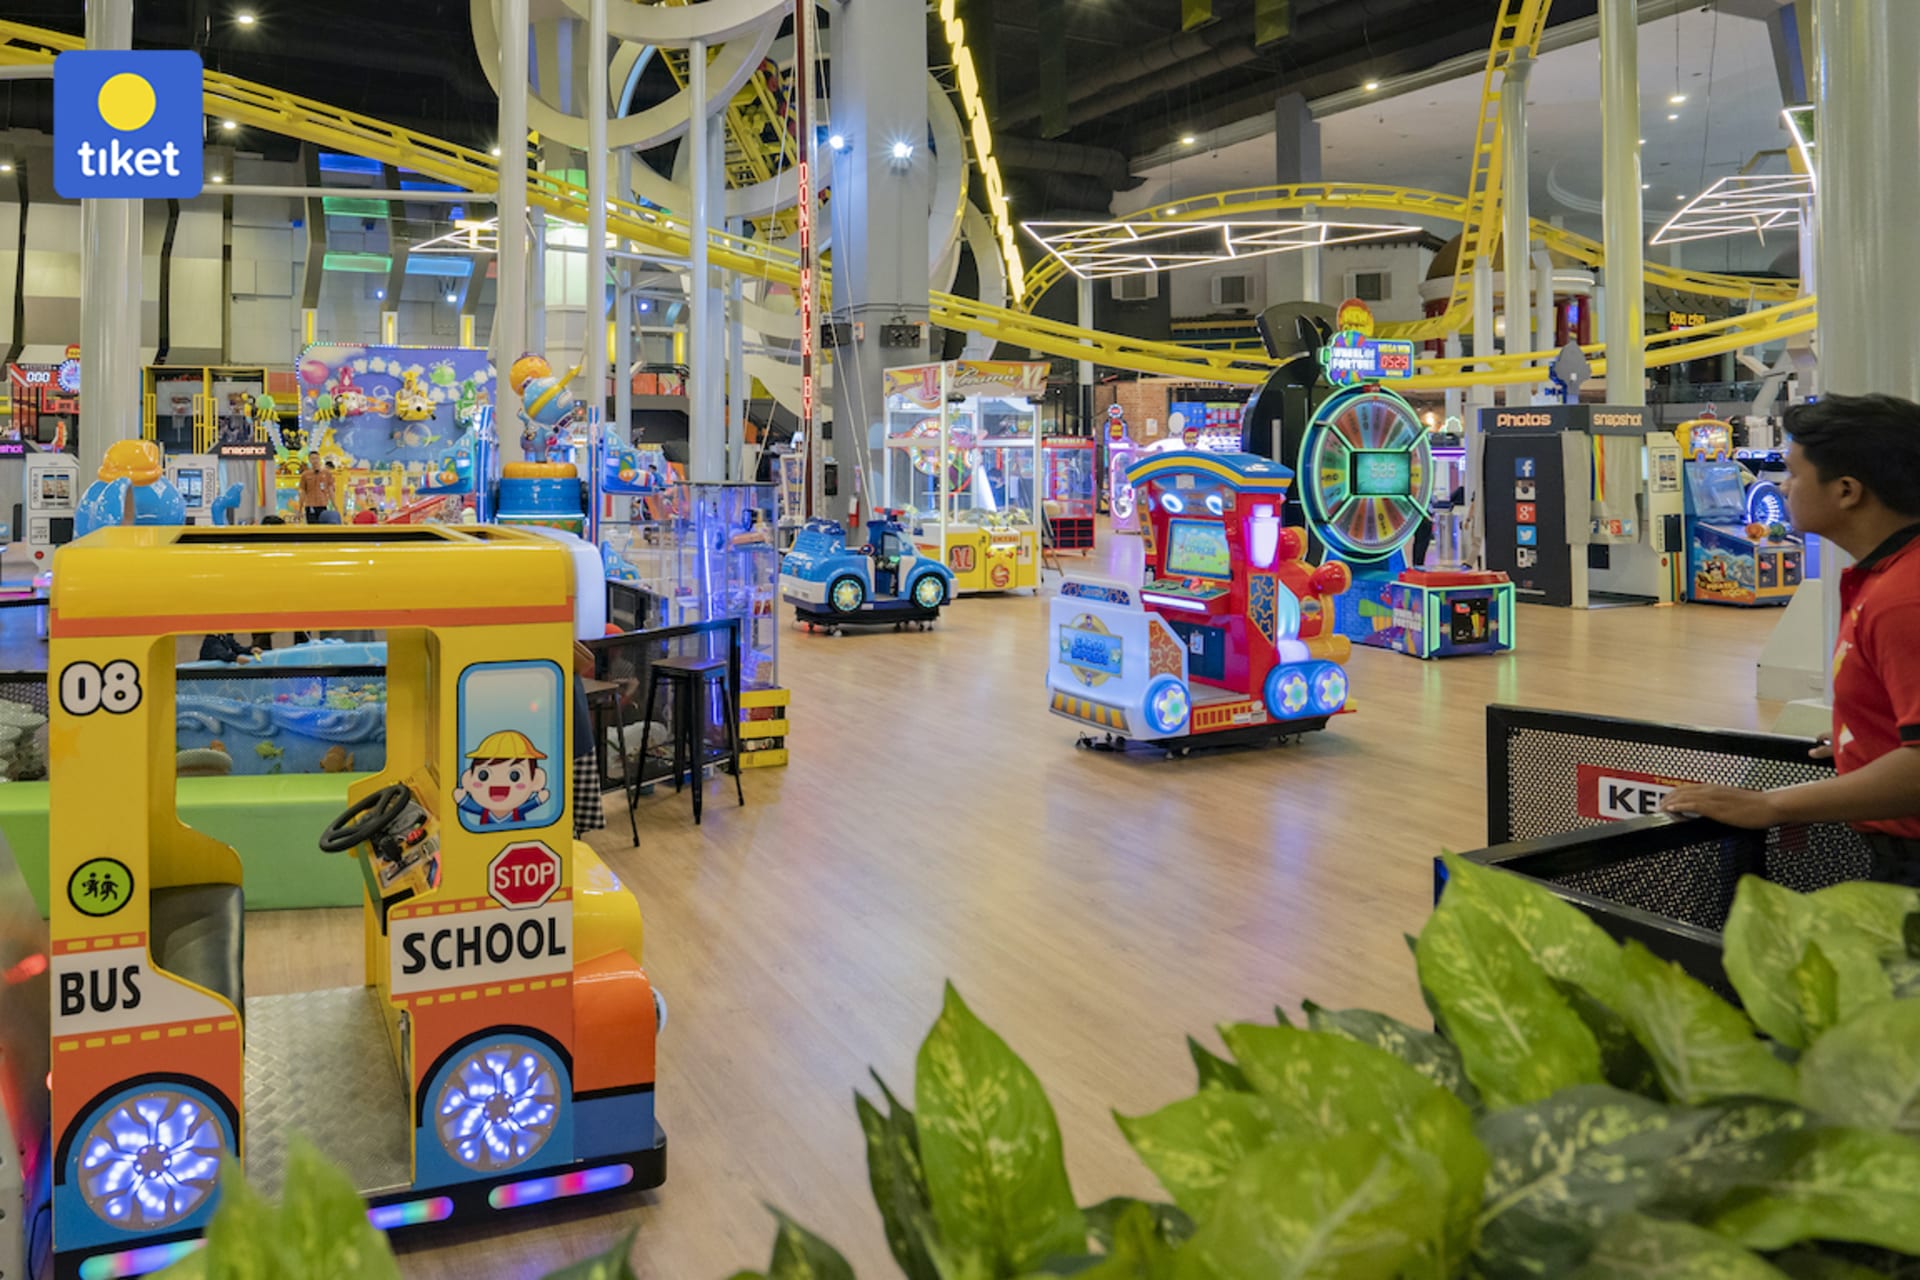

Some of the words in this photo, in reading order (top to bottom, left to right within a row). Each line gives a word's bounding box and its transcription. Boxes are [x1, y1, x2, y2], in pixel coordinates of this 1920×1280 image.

[799, 162, 810, 248] DONT
[800, 268, 812, 355] WALK
[803, 376, 812, 420] BY
[1496, 413, 1552, 428] photos
[1593, 413, 1643, 428] snapshot
[59, 659, 143, 717] 08
[496, 862, 554, 889] STOP
[402, 917, 566, 975] SCHOOL
[60, 965, 141, 1016] BUS
